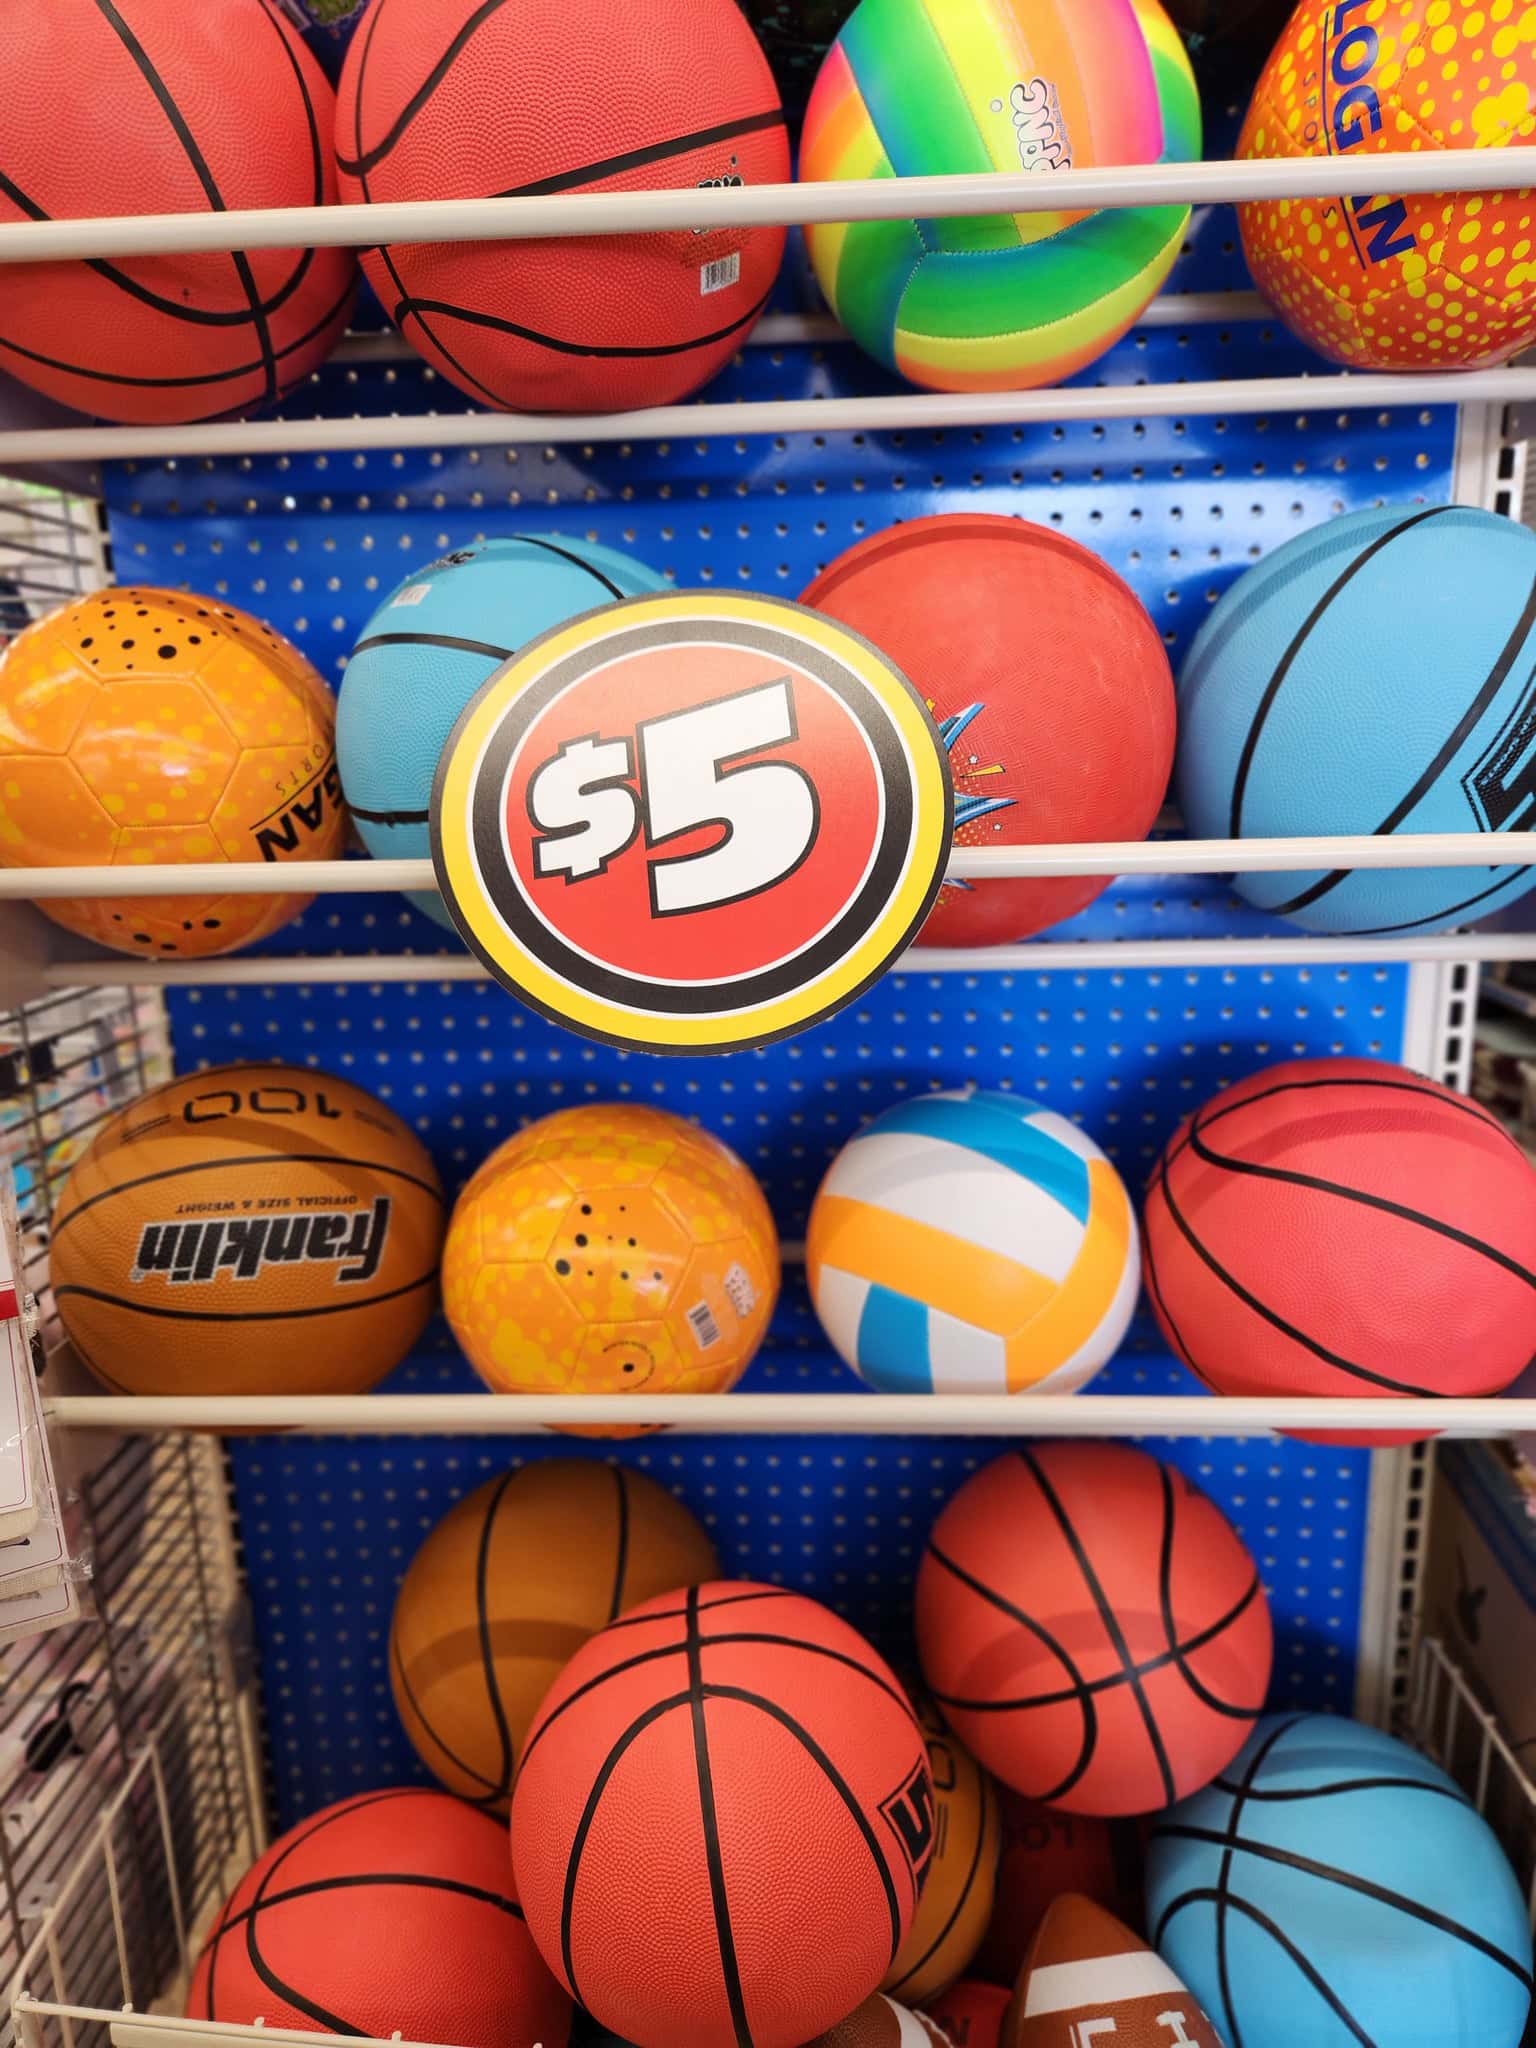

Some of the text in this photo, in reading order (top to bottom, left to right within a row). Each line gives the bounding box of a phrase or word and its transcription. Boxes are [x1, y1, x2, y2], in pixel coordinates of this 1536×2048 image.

[1303, 72, 1337, 219] SPOS
[1331, 0, 1417, 264] LOGN
[526, 675, 821, 919] $5
[184, 1088, 342, 1124] 100
[176, 1201, 236, 1214] WEIGHT
[258, 1198, 291, 1208] SIZE
[297, 1195, 358, 1207] OFFICIAL
[135, 1196, 392, 1285] franklin
